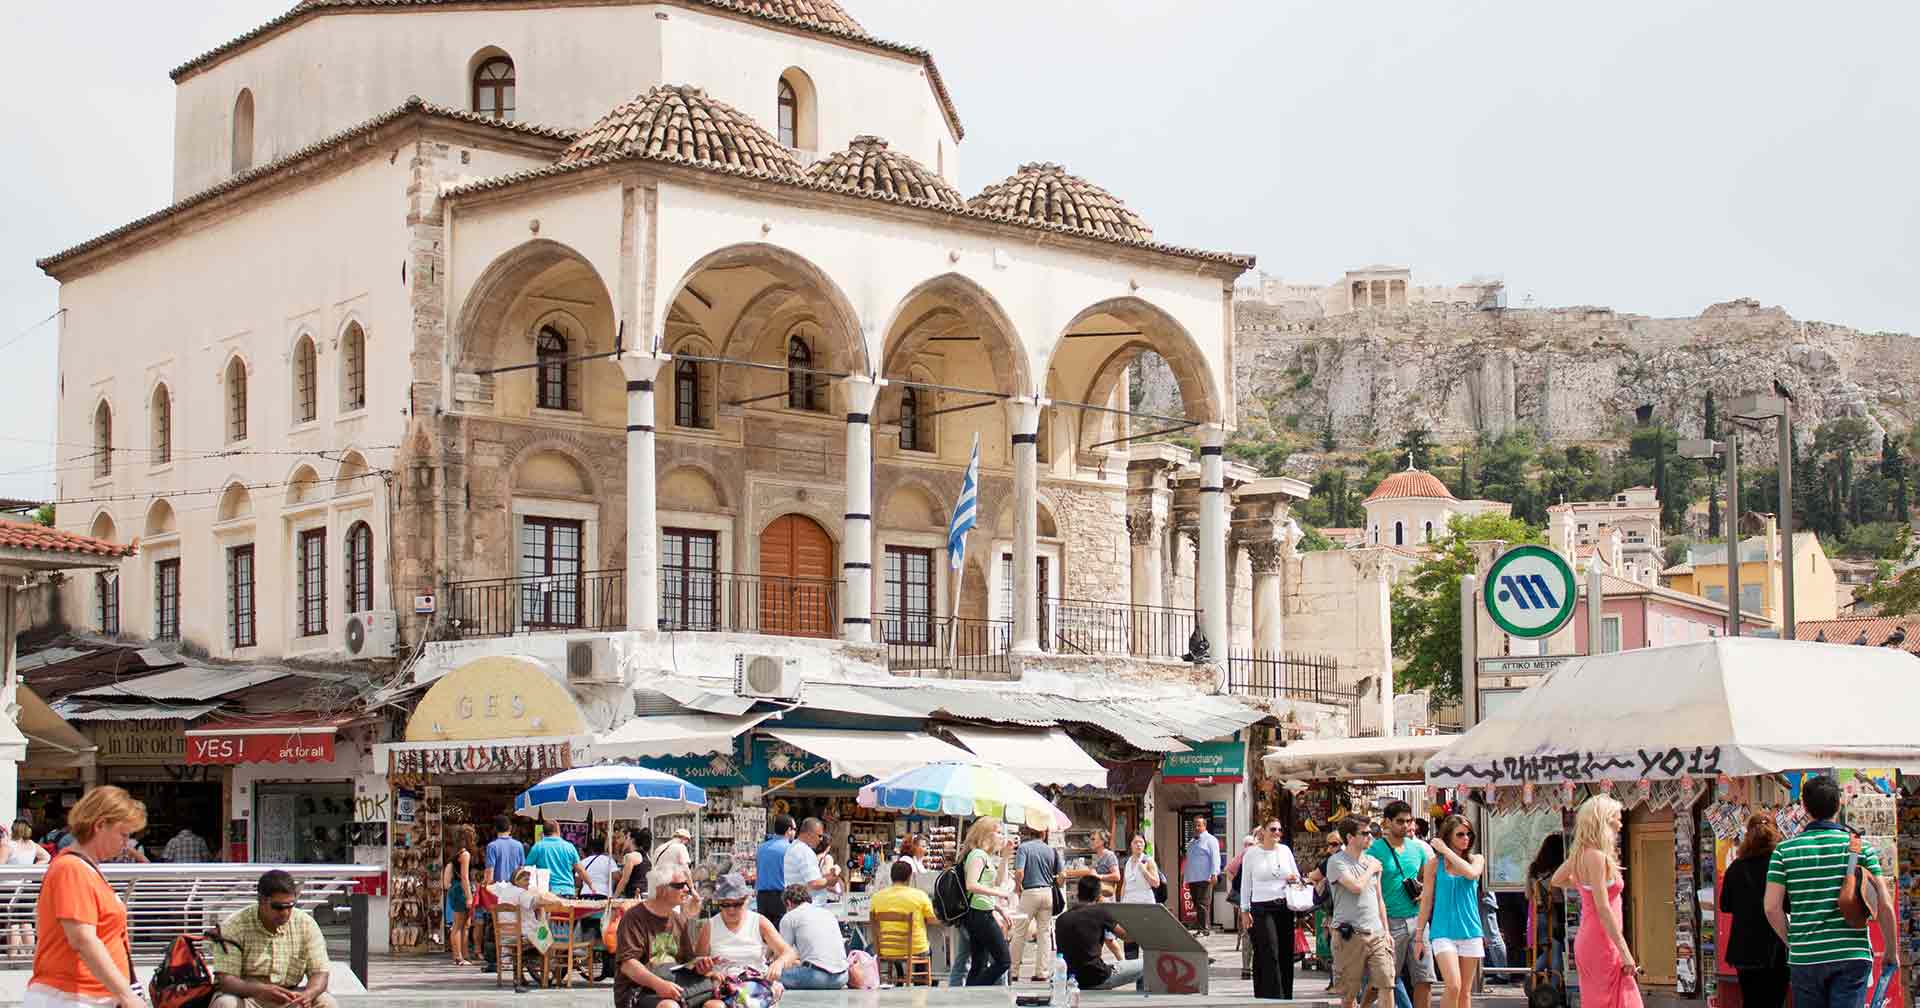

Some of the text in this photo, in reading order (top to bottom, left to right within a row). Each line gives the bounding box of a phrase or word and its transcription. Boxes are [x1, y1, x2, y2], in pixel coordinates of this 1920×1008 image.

[108, 736, 121, 754] in
[125, 735, 148, 754] the
[151, 735, 172, 754] old
[279, 745, 324, 758] art for all
